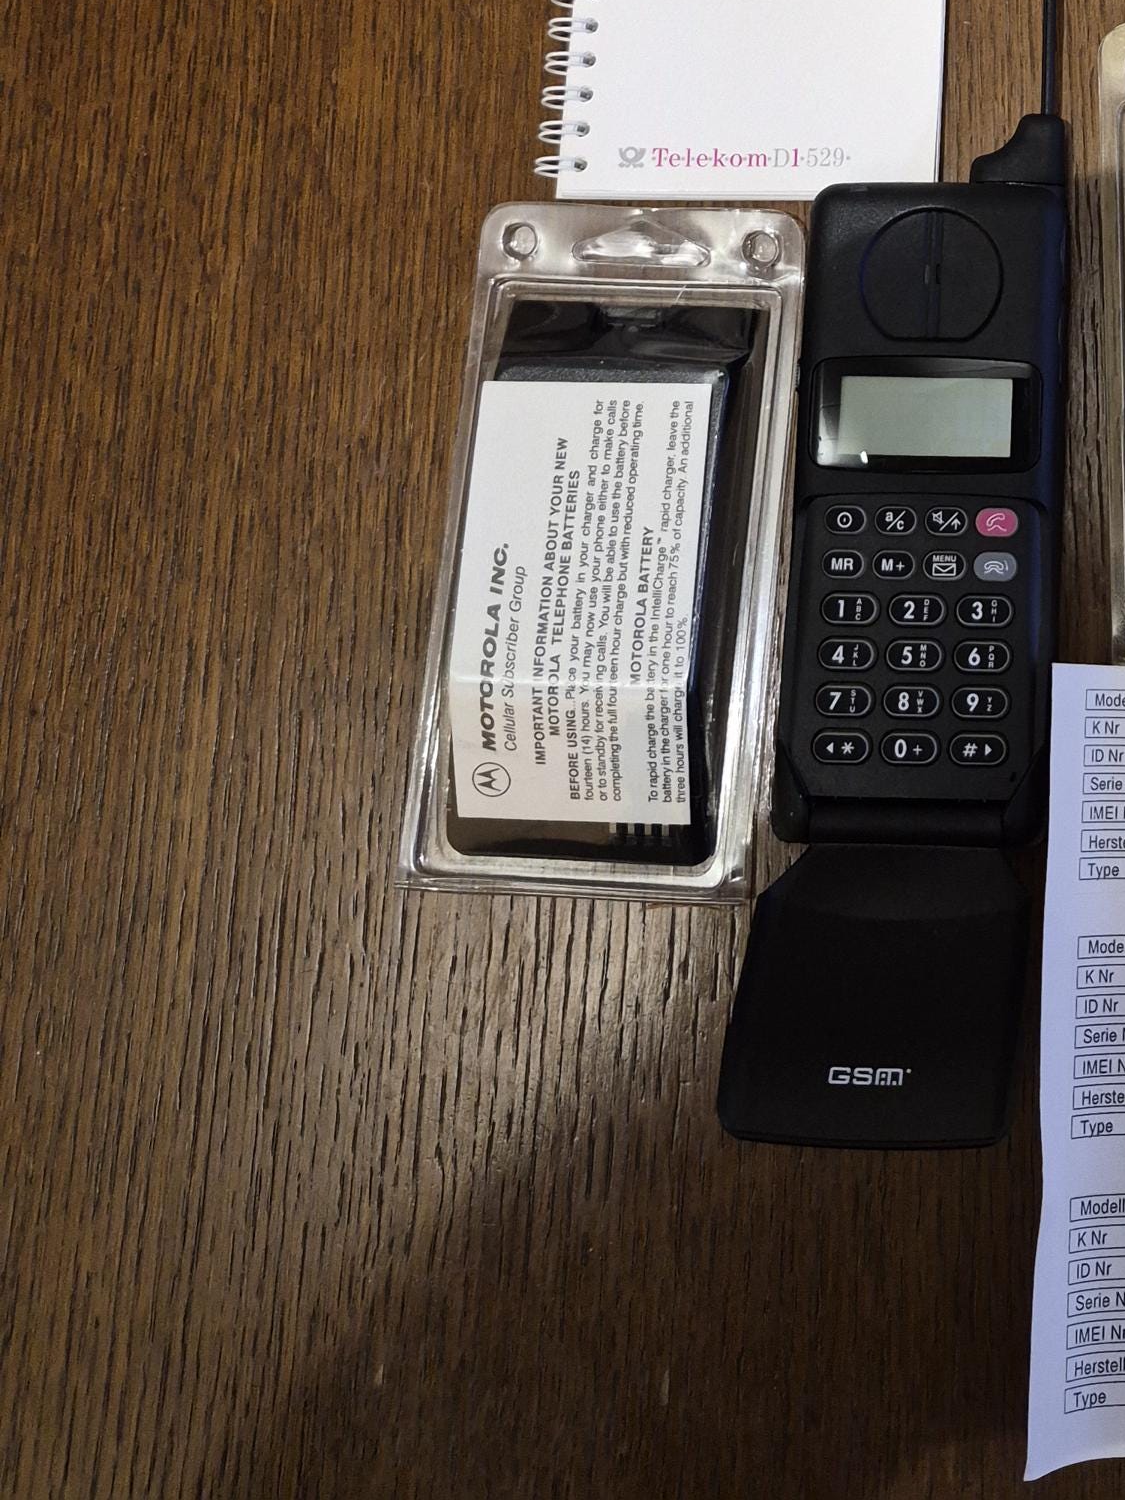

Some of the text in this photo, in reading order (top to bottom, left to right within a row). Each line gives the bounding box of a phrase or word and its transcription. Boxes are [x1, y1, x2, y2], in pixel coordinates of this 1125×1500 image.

[606, 400, 618, 425] calls
[555, 437, 568, 470] NEW
[602, 429, 614, 460] make
[599, 464, 611, 475] to
[550, 475, 564, 516] YOUR
[598, 479, 610, 510] either
[593, 515, 606, 552] phone
[544, 520, 559, 571] ABOUT
[590, 557, 602, 582] your
[831, 558, 854, 571] MR
[509, 566, 527, 612] Group
[588, 587, 599, 608] use
[548, 470, 580, 736] MOTOROLA TELEPHONE BATTERIES
[630, 526, 654, 685] MOTOROLA BATTERY
[838, 600, 844, 618] 1
[903, 600, 916, 620] 2
[971, 601, 984, 620] 3
[585, 612, 596, 637] now
[480, 543, 509, 751] MOTOROLA INC.
[582, 642, 595, 667] may
[831, 645, 845, 664] 4
[900, 646, 913, 665] 5
[968, 647, 981, 666] 6
[829, 691, 842, 710] 7
[898, 692, 910, 711] 8
[966, 693, 980, 712] 9
[503, 702, 517, 751] Cellular
[532, 687, 546, 765] IMPORTANT
[1092, 721, 1120, 735] K Nr
[581, 735, 593, 754] (14)
[1092, 749, 1124, 763] ID Nr
[583, 758, 594, 800] fourteen
[1090, 777, 1122, 791] Serie
[1090, 806, 1118, 820] IMEI
[1088, 863, 1119, 879] Type
[828, 1066, 904, 1086] GSM
